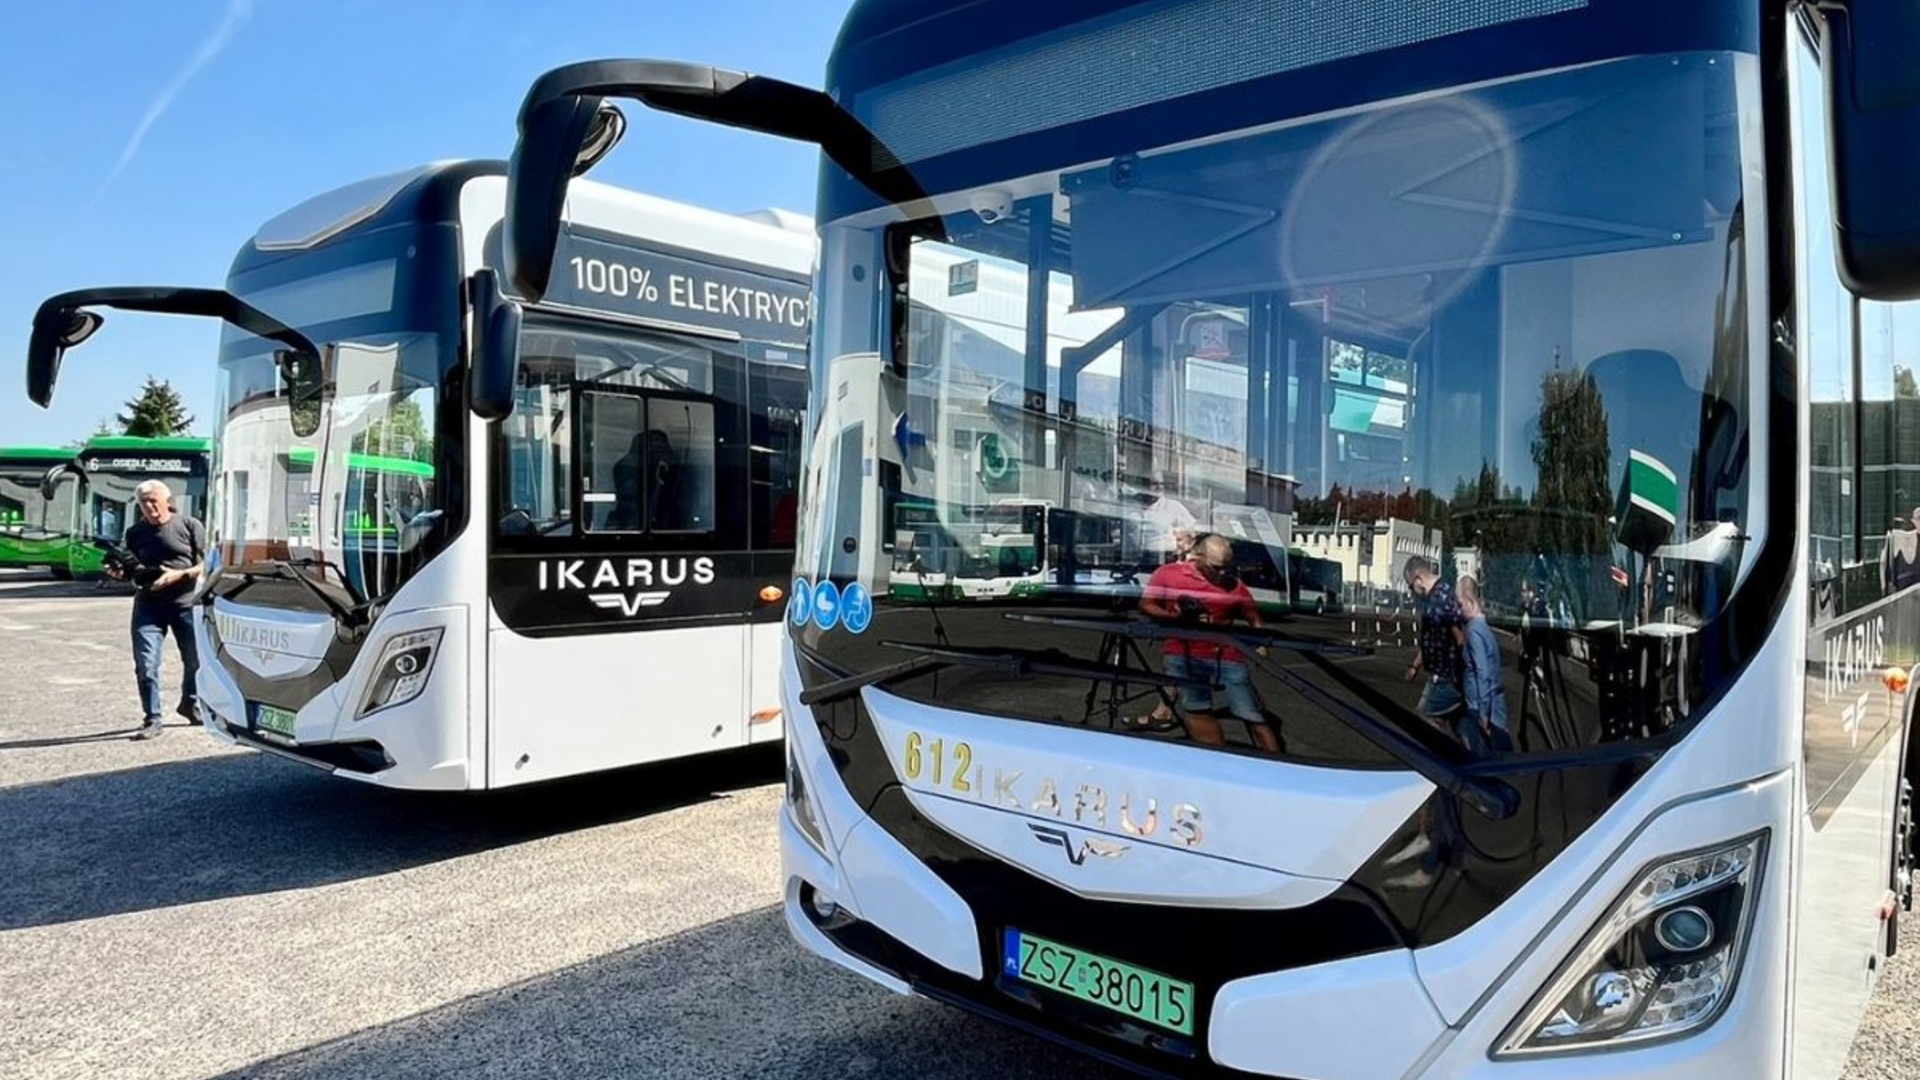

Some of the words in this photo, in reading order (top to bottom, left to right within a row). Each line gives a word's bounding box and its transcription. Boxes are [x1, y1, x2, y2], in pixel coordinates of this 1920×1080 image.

[571, 256, 658, 302] 100%
[90, 458, 99, 471] 6
[538, 557, 716, 590] IKARUS
[236, 624, 290, 651] IKARUS
[1825, 615, 1884, 704] IKARUS
[905, 731, 972, 792] 612
[975, 764, 1204, 847] IKARUS
[1020, 939, 1076, 992] ZSZ
[1087, 961, 1185, 1026] 38015
